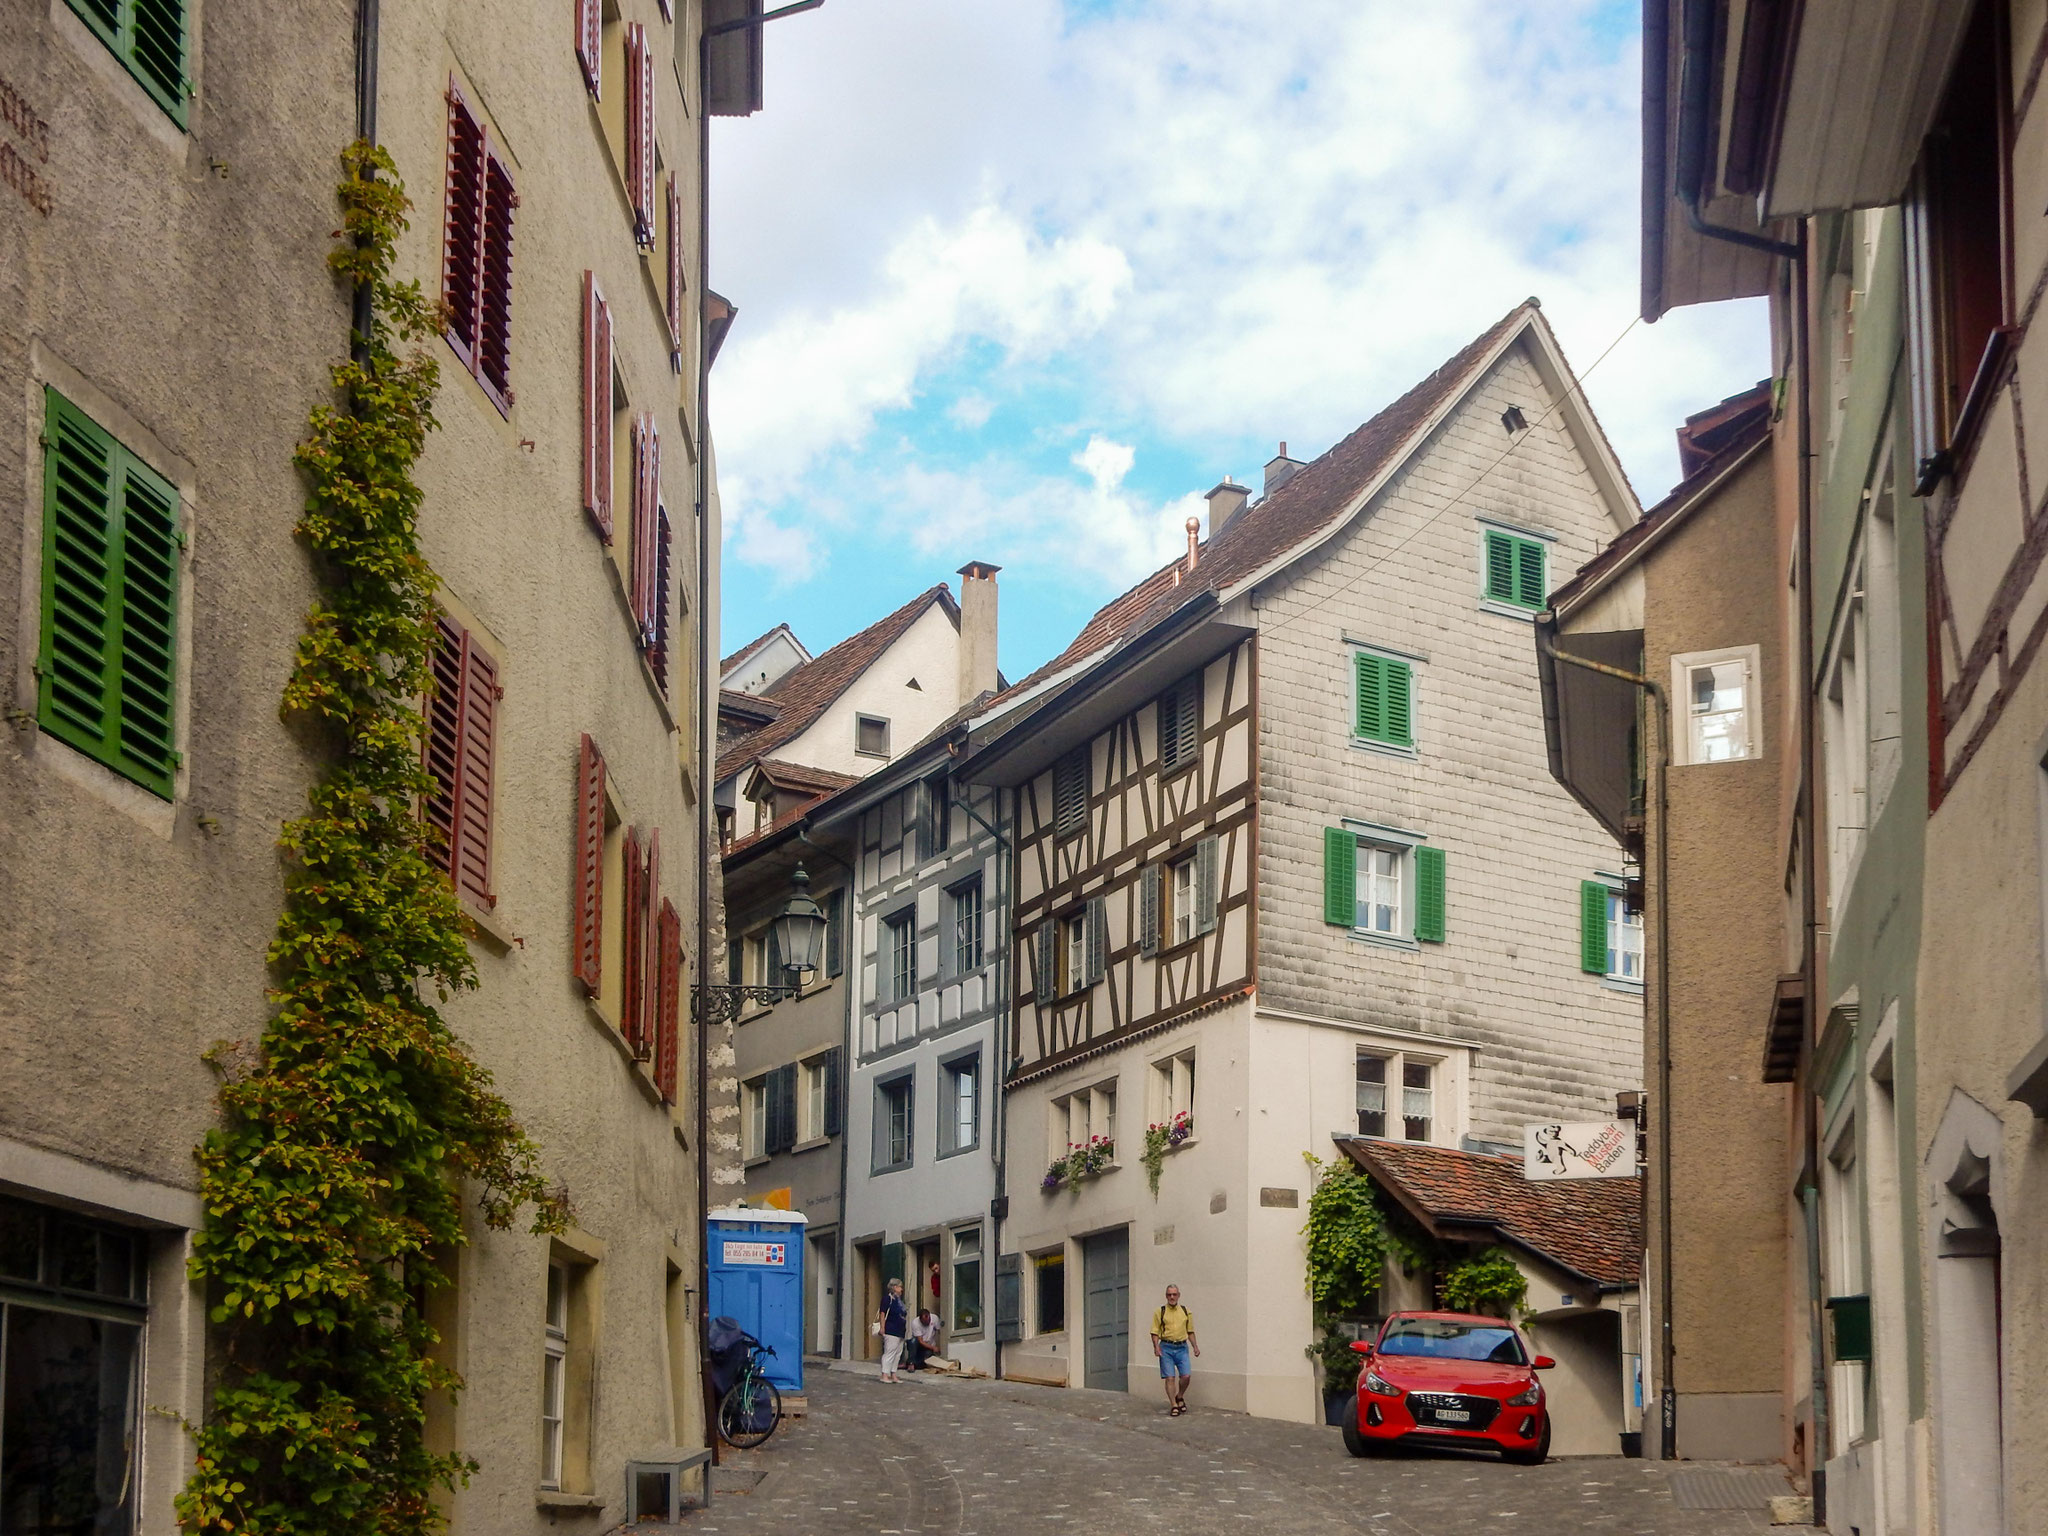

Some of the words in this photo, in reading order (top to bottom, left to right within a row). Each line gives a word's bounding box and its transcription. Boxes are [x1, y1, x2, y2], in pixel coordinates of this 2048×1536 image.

[1577, 1123, 1617, 1162] Teddybär
[1587, 1130, 1625, 1168] Museum
[1595, 1144, 1626, 1174] Baden
